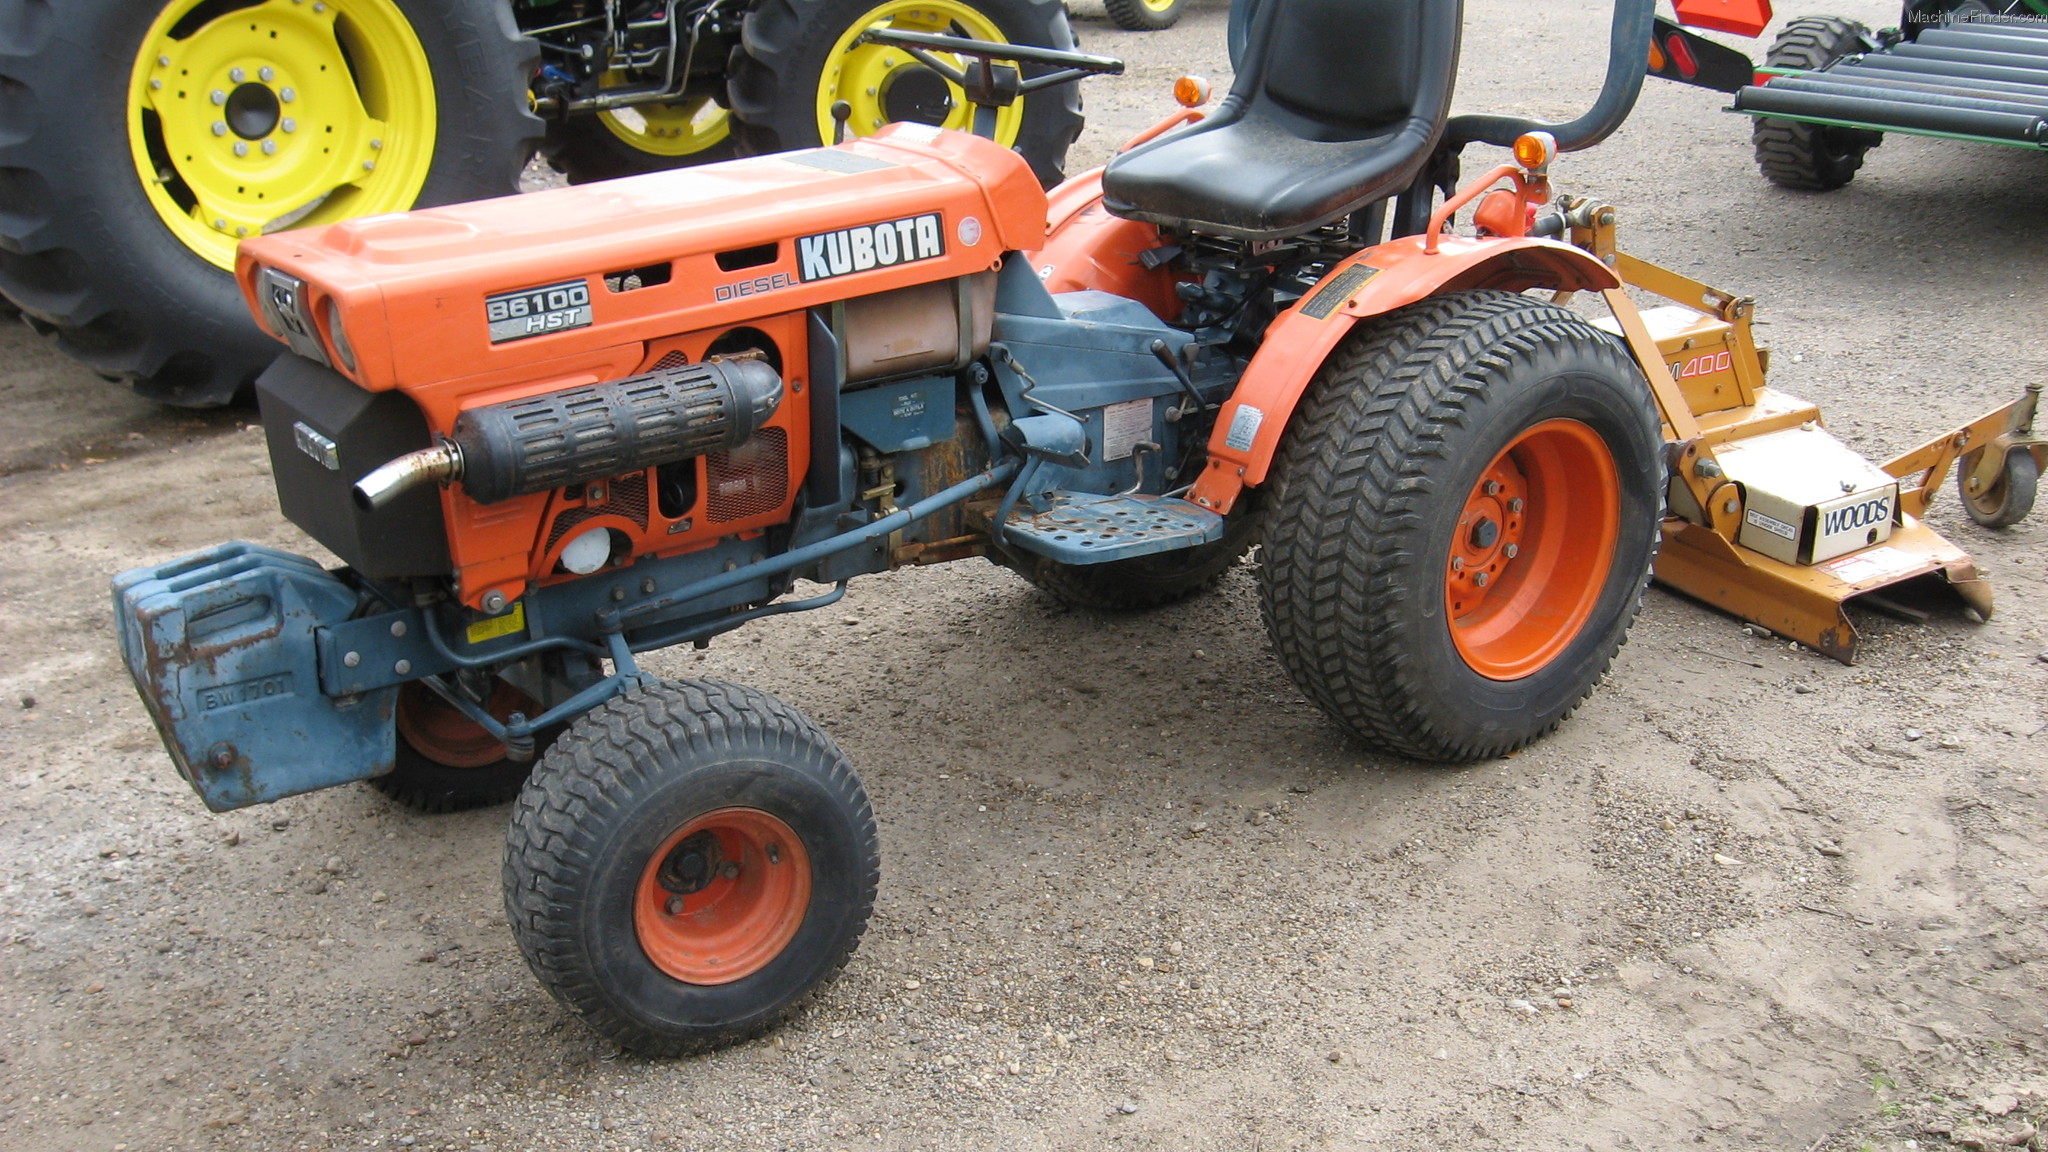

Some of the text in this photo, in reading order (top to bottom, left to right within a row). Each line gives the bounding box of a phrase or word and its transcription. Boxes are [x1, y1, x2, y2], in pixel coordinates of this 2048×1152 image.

[799, 214, 940, 281] KUBOTA
[487, 285, 590, 322] B6100
[715, 272, 799, 302] DIESEL
[526, 308, 581, 333] HST
[1824, 496, 1889, 537] WOODS
